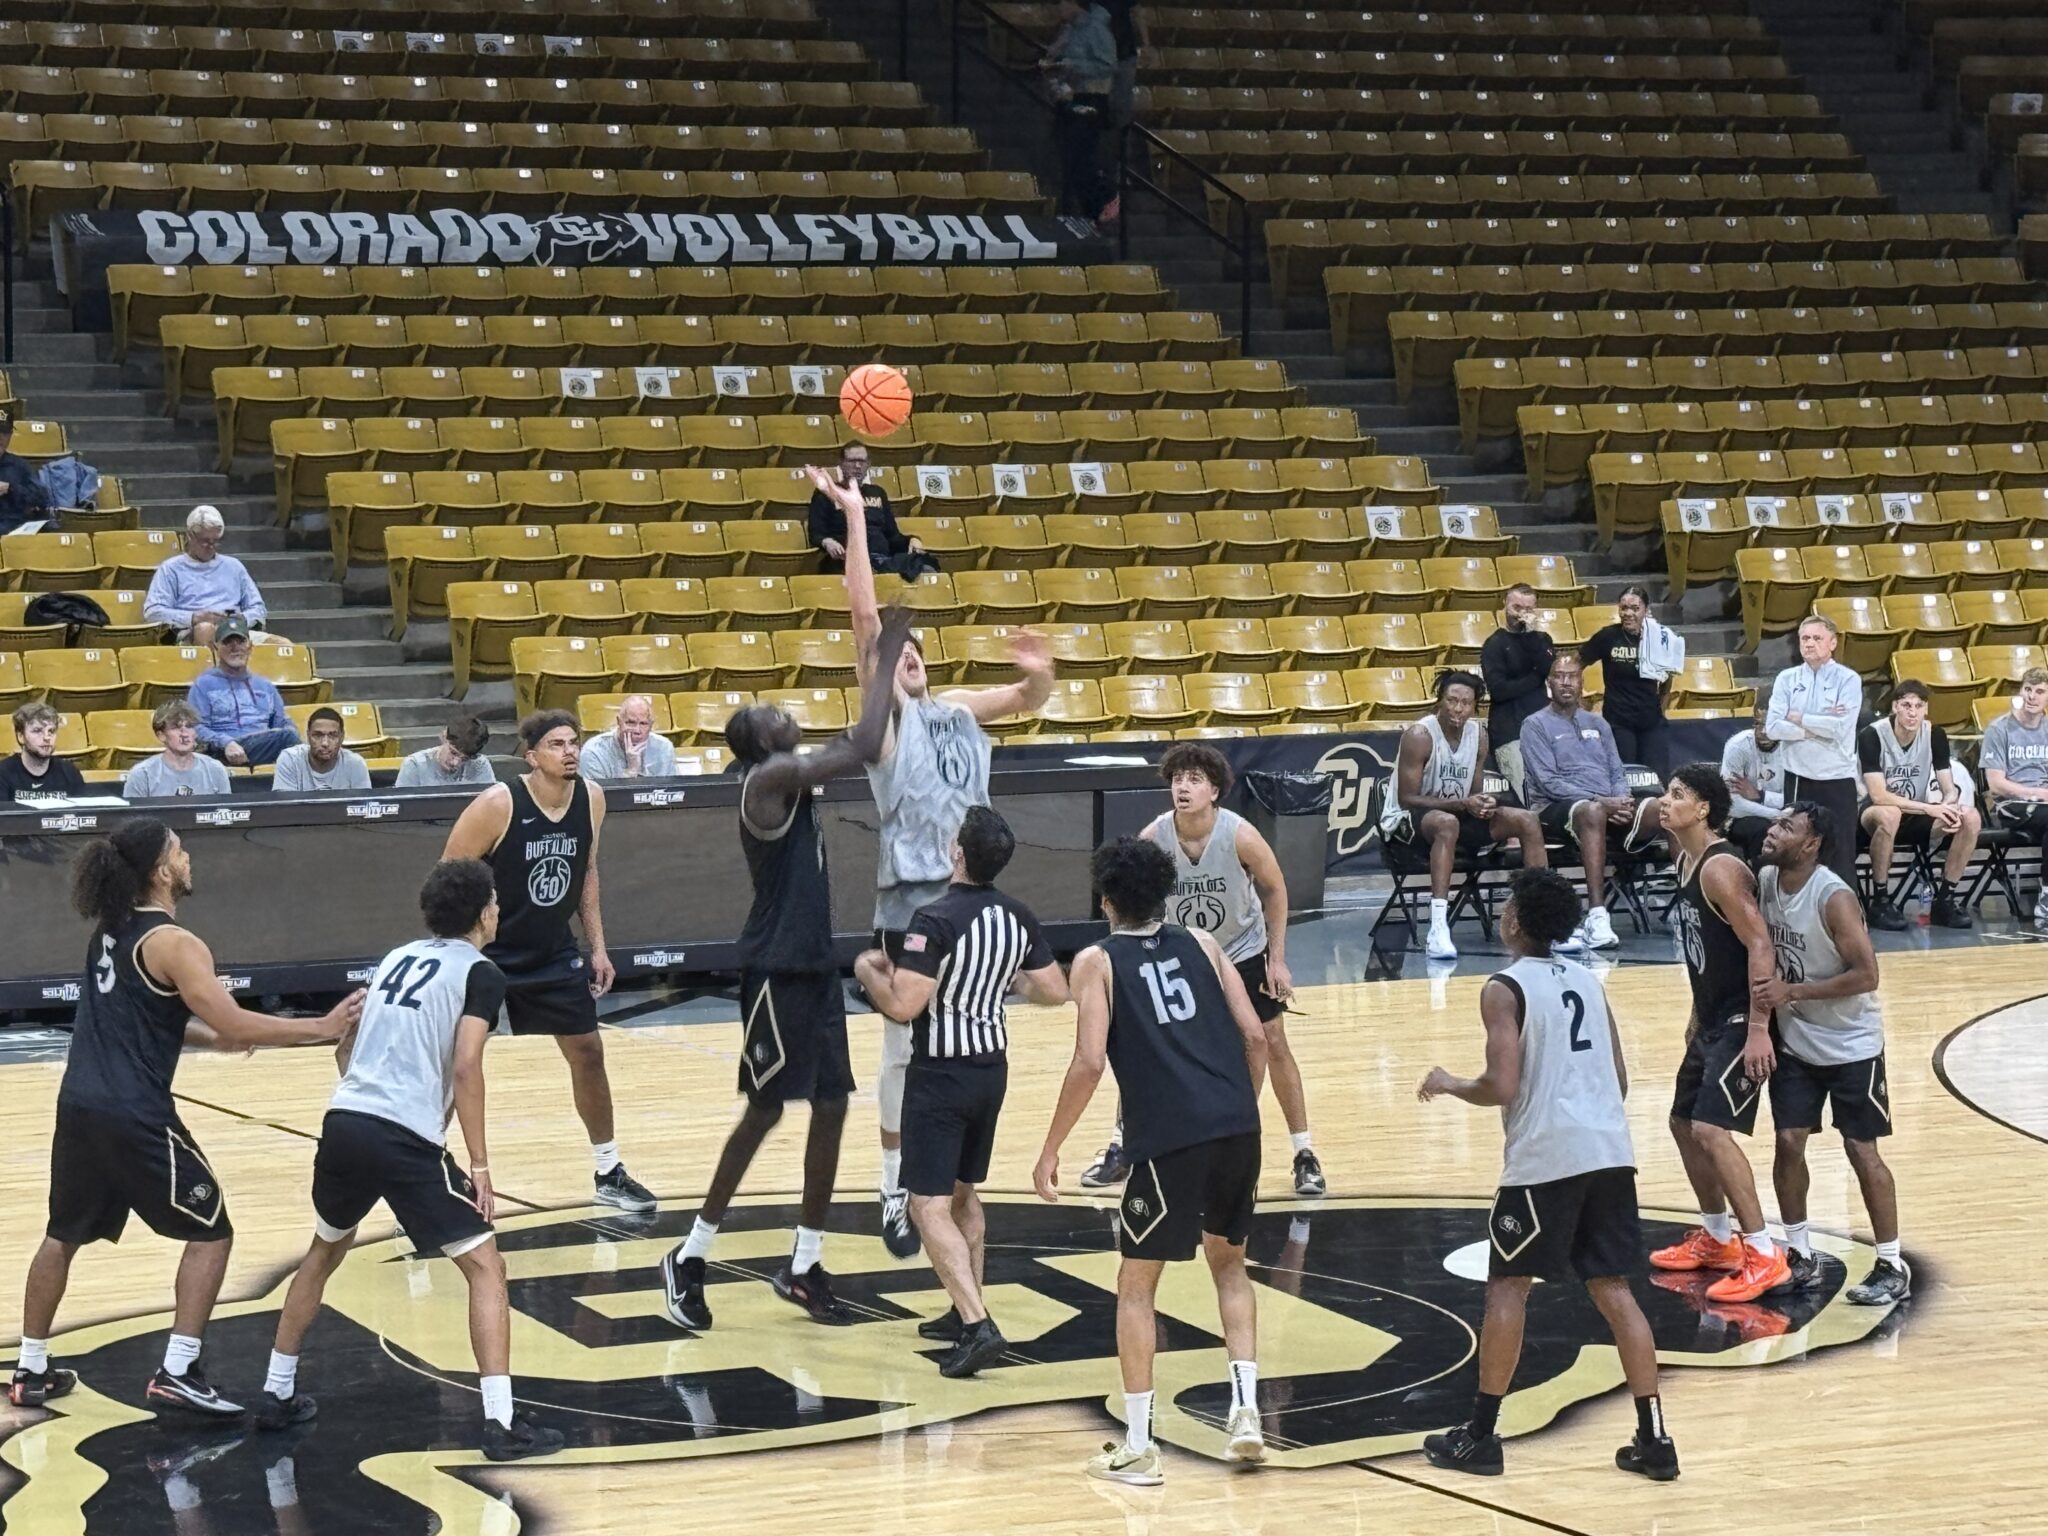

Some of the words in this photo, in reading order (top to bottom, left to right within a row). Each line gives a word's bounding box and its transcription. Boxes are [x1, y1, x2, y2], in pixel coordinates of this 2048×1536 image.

[137, 208, 540, 264] COLORADO
[623, 212, 1057, 262] VOLLEYBALL
[538, 876, 560, 900] 50
[1196, 911, 1207, 929] 0
[96, 933, 117, 994] 5
[377, 954, 442, 1011] 42
[1138, 956, 1198, 1026] 15
[1560, 989, 1593, 1054] 2
